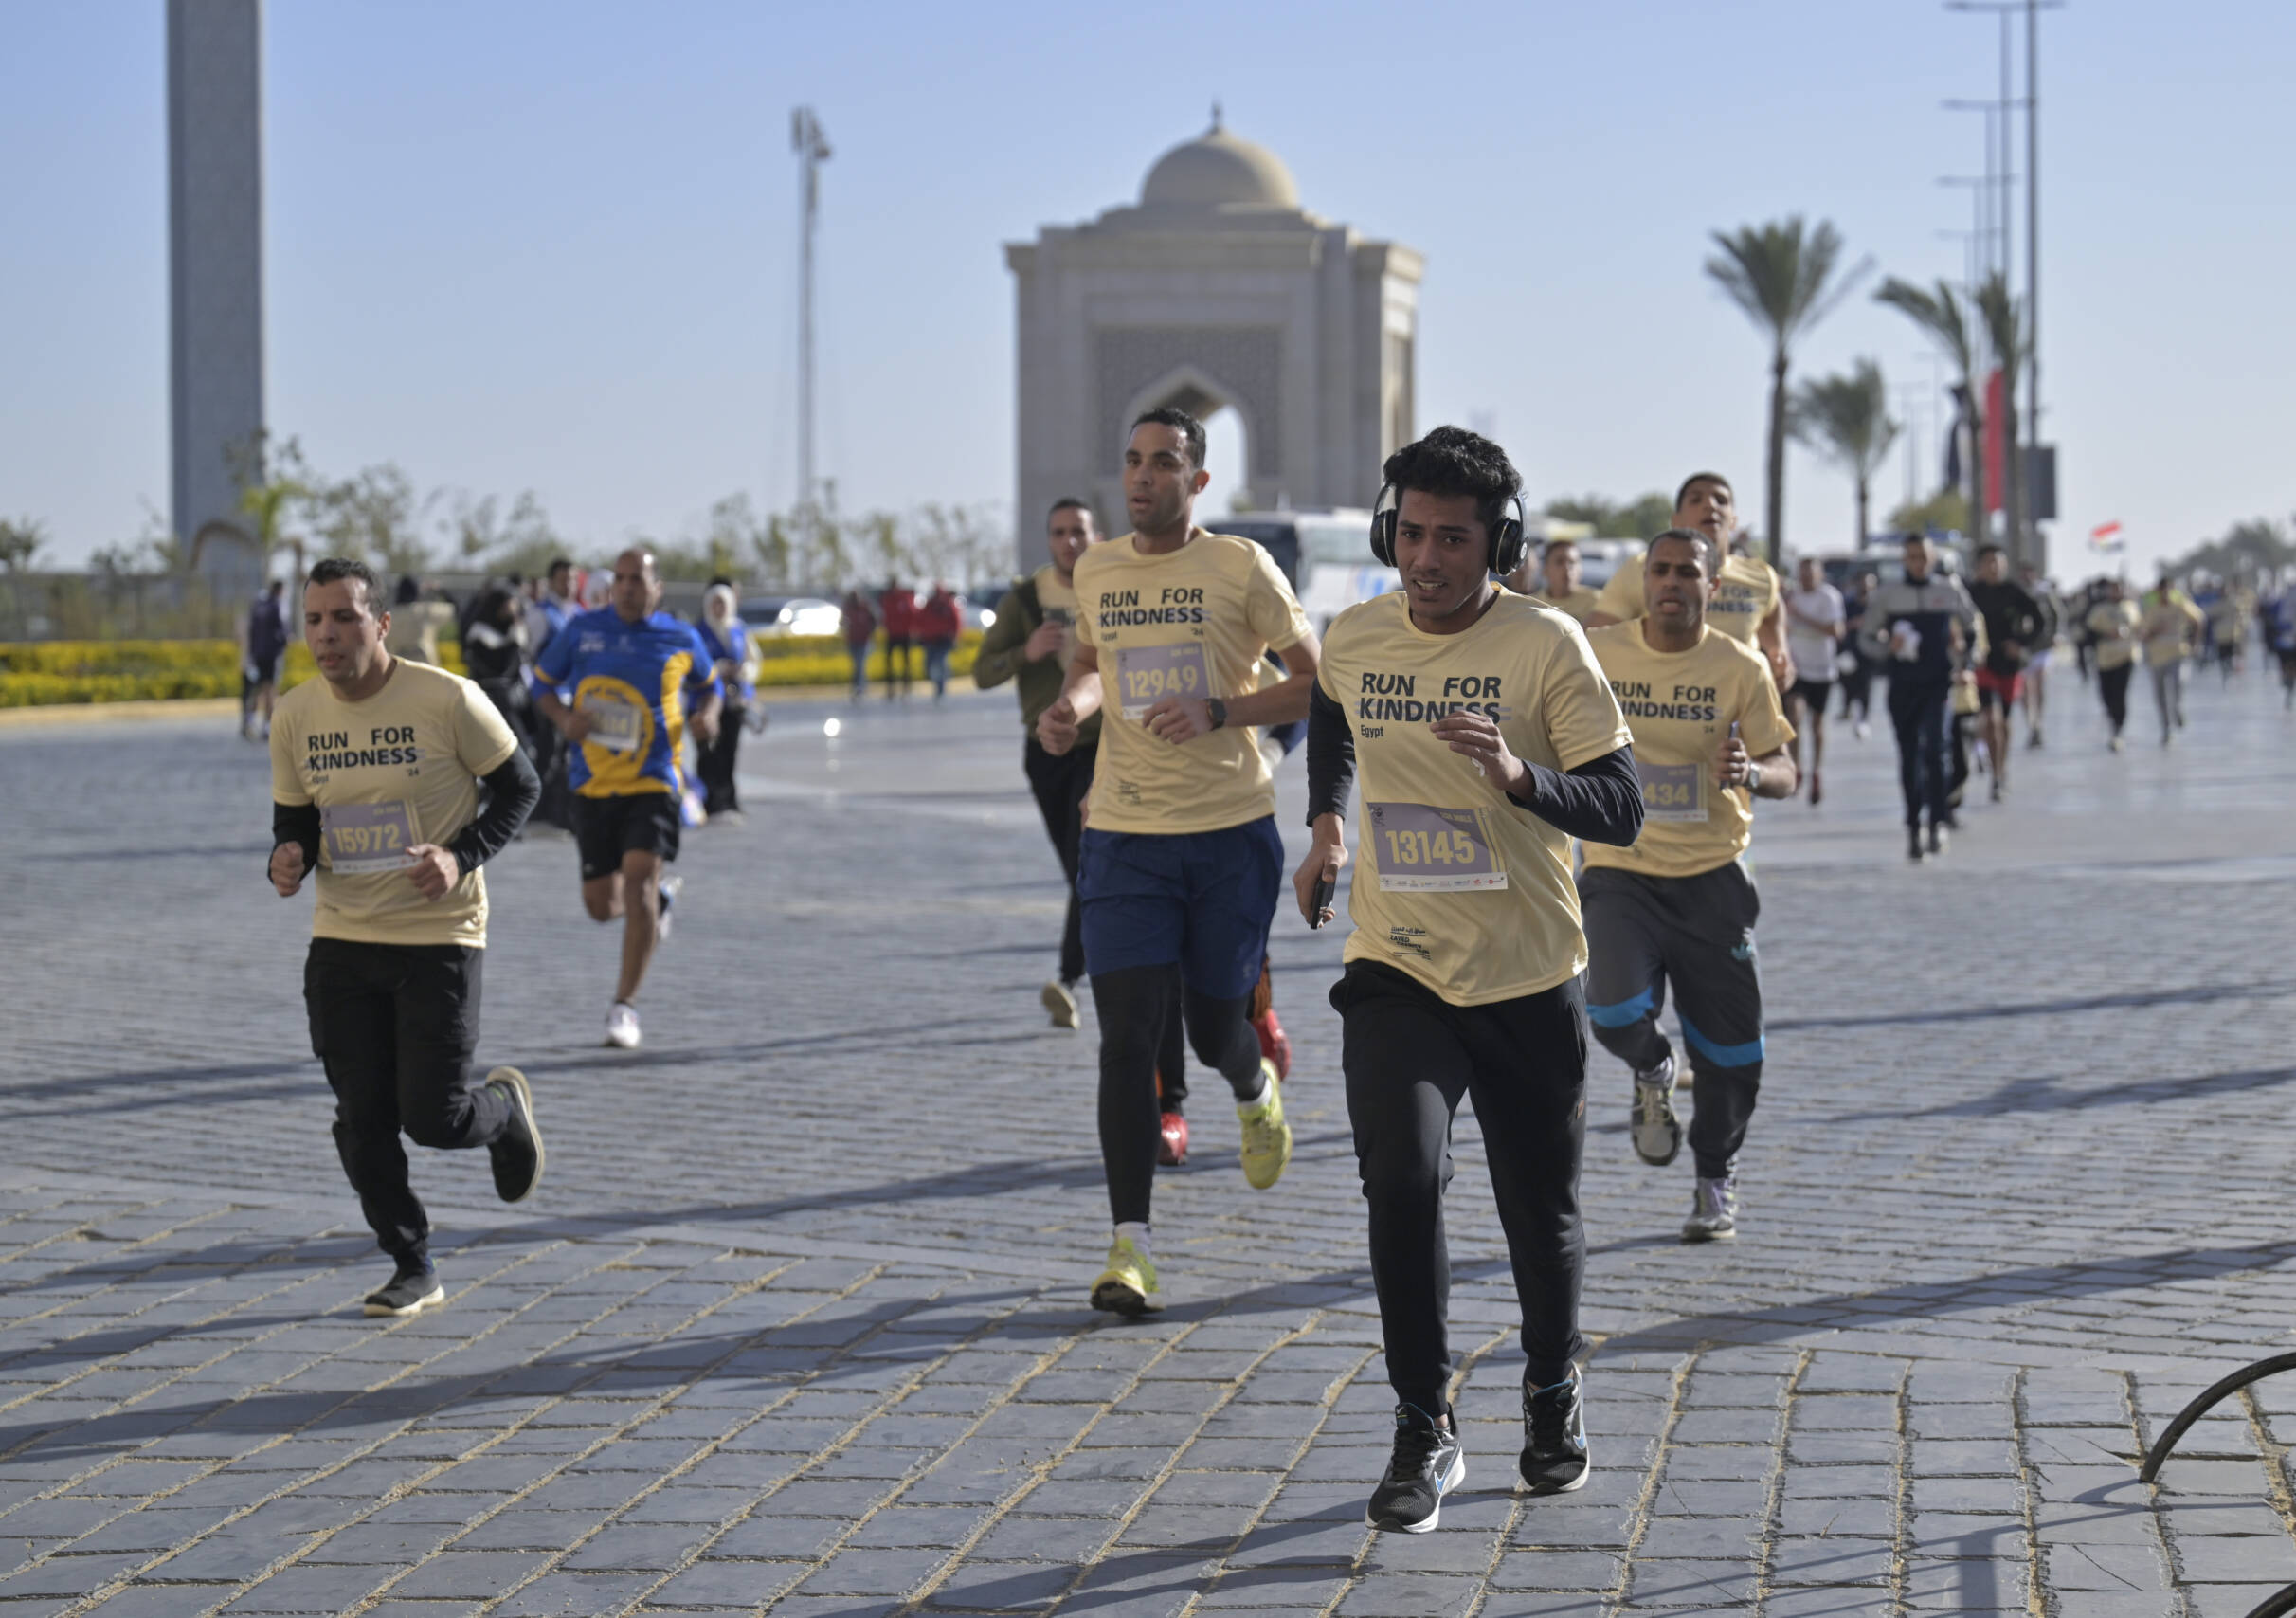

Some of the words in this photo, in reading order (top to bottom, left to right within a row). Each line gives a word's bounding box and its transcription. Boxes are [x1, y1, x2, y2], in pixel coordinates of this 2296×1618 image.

[1100, 590, 1139, 609] RUN
[1161, 588, 1203, 605] FOR
[1100, 607, 1203, 628] KINDNESS
[1125, 664, 1198, 699] 12949
[1361, 672, 1416, 697] RUN
[1443, 676, 1502, 699] FOR
[1611, 681, 1651, 699] RUN
[1672, 685, 1716, 702] FOR
[1618, 700, 1715, 721] INDNESS
[308, 731, 348, 751] RUN
[371, 726, 415, 745] FOR
[1360, 724, 1384, 738] Egypt
[309, 746, 418, 771] KINDNESS
[1643, 782, 1690, 805] 434
[333, 823, 403, 853] 15972
[1384, 829, 1475, 864] 13145
